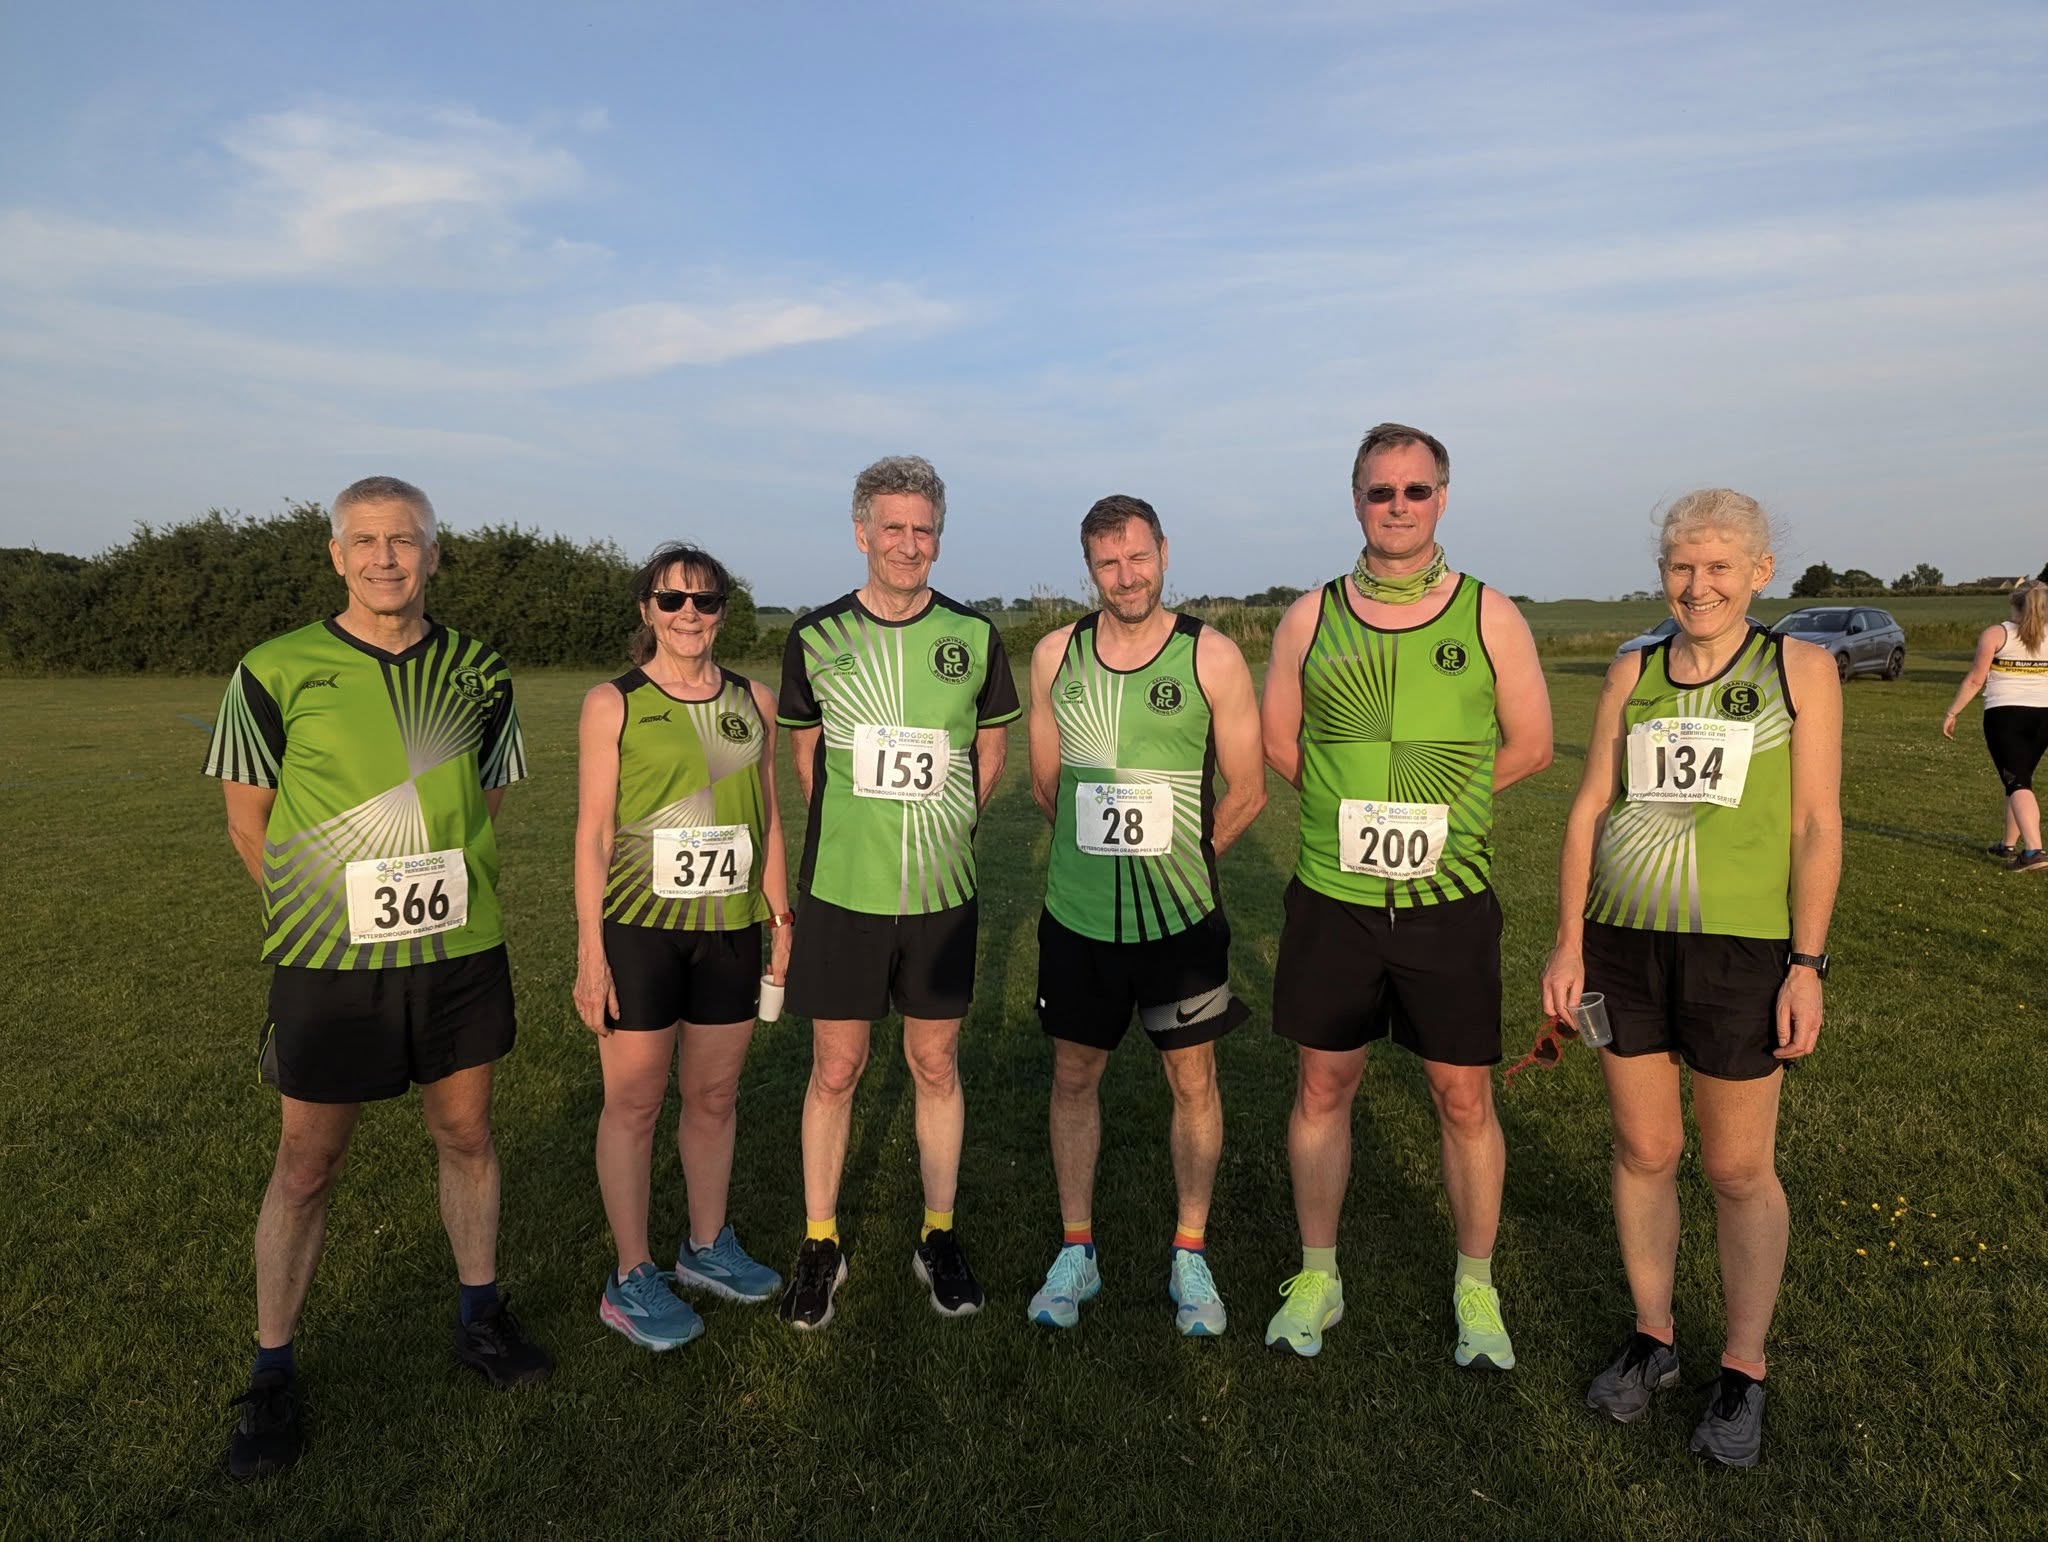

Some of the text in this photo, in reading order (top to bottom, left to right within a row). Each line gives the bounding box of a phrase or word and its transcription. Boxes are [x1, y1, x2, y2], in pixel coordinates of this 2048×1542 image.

[943, 643, 960, 663] G
[1443, 645, 1458, 660] G
[943, 663, 964, 674] RC
[1442, 659, 1460, 669] RC
[1157, 683, 1173, 699] G
[1722, 680, 1758, 690] GRANTHAM
[1156, 697, 1174, 708] RC
[1730, 687, 1749, 704] G
[1719, 709, 1761, 721] RUNNING CLUB
[1730, 703, 1751, 714] RC
[876, 750, 933, 790] 153
[1656, 746, 1723, 790] 134
[1717, 795, 1736, 803] SERIES
[1103, 808, 1143, 845] 28
[1360, 826, 1428, 868] 200
[674, 849, 737, 887] 374
[375, 879, 449, 929] 366
[359, 930, 412, 940] PETERBOROUGH
[413, 925, 433, 933] GRAND
